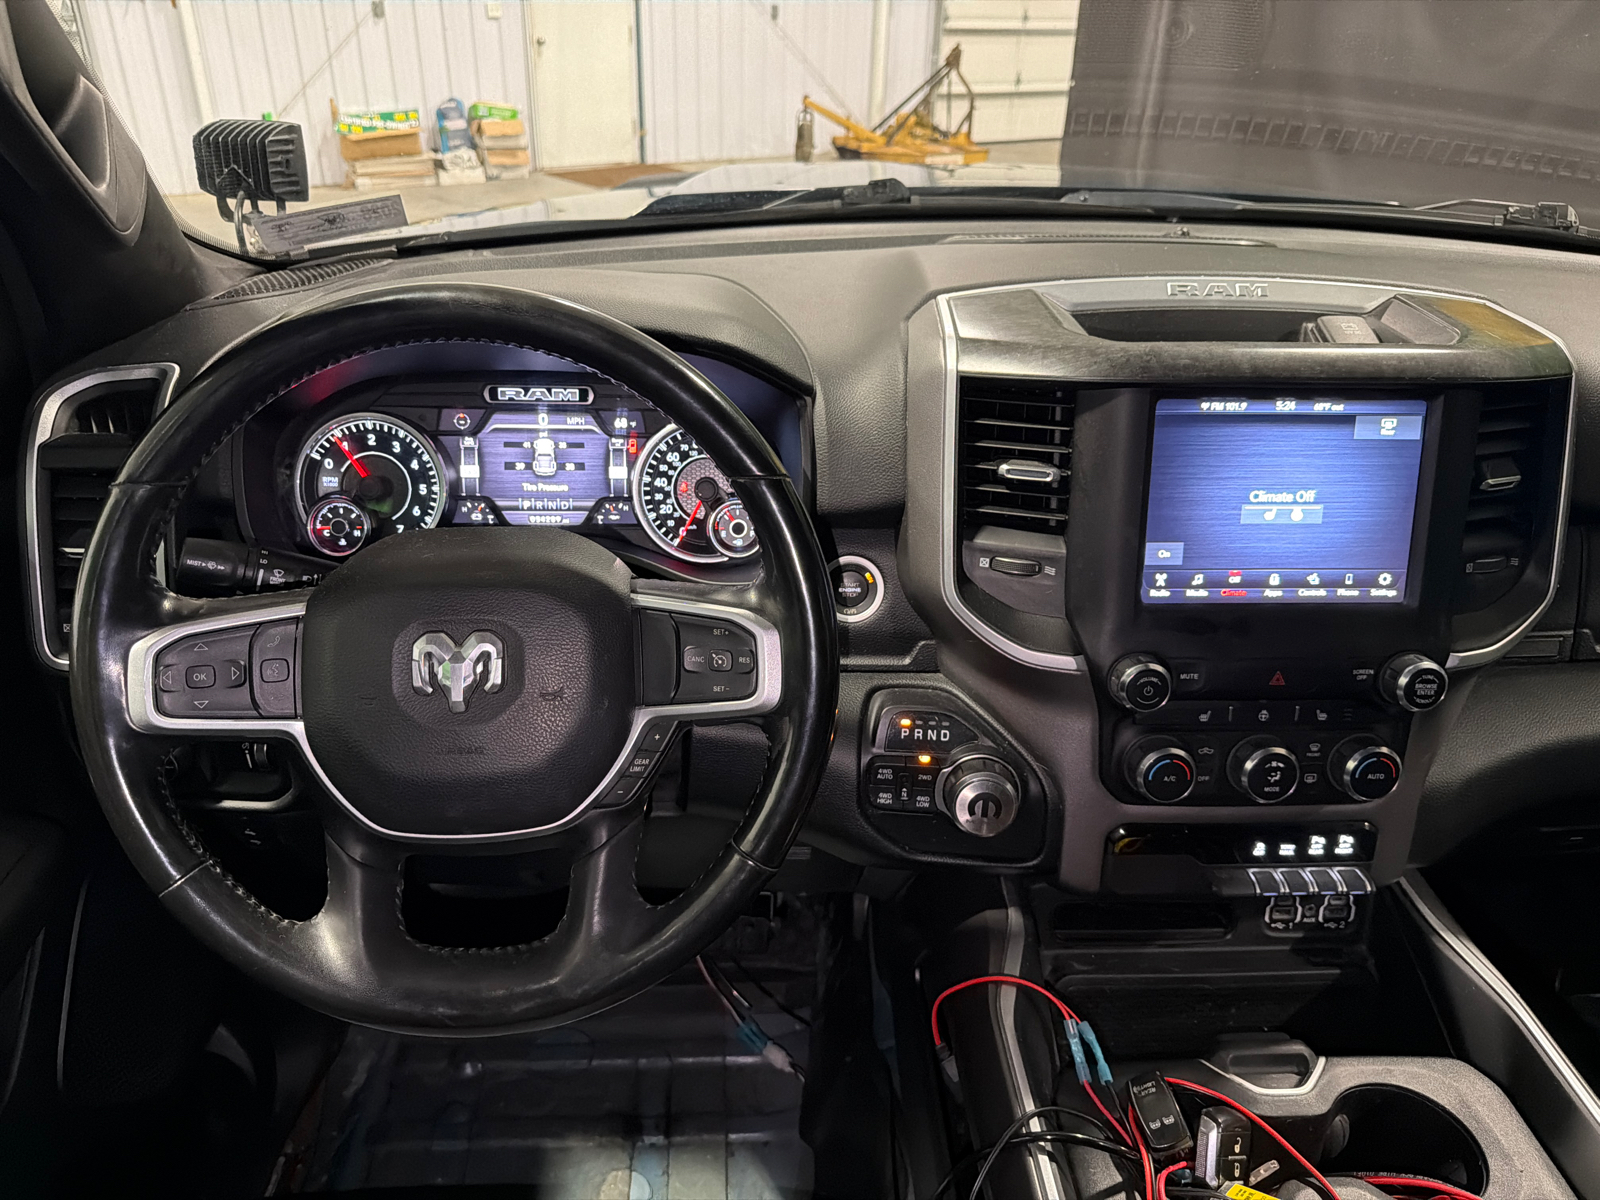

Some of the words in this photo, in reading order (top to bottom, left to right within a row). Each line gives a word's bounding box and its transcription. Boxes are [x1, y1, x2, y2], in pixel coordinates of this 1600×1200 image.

[1166, 281, 1269, 298] RAM
[497, 387, 580, 401] RAM
[1210, 402, 1225, 411] FM
[1225, 402, 1248, 411] 101.9
[538, 413, 549, 426] 0
[566, 417, 585, 425] MPH
[367, 433, 377, 446] 2
[391, 441, 401, 453] 3
[680, 443, 689, 451] 70
[666, 452, 680, 462] 60
[324, 458, 334, 469] 0
[410, 459, 419, 470] 4
[659, 464, 668, 472] 50
[654, 477, 668, 487] 40
[419, 484, 428, 495] 5
[654, 493, 663, 501] 30
[1249, 489, 1293, 503] Climate
[1296, 489, 1317, 503] Off
[522, 500, 531, 510] P
[535, 501, 544, 510] R
[547, 501, 557, 510] N
[560, 501, 569, 510] D
[660, 504, 673, 514] 20
[412, 505, 421, 516] 6
[667, 519, 675, 527] 10
[323, 529, 330, 537] C
[396, 524, 405, 533] 7
[721, 530, 727, 538] E
[1158, 549, 1171, 559] On
[186, 559, 202, 567] MIST
[1220, 588, 1248, 597] Climate
[687, 655, 705, 663] CANC
[738, 656, 750, 664] RES
[193, 672, 207, 681] OK
[901, 729, 909, 739] P
[914, 729, 923, 740] R
[927, 730, 937, 741] N
[940, 730, 950, 741] D
[1338, 920, 1346, 928] 2
